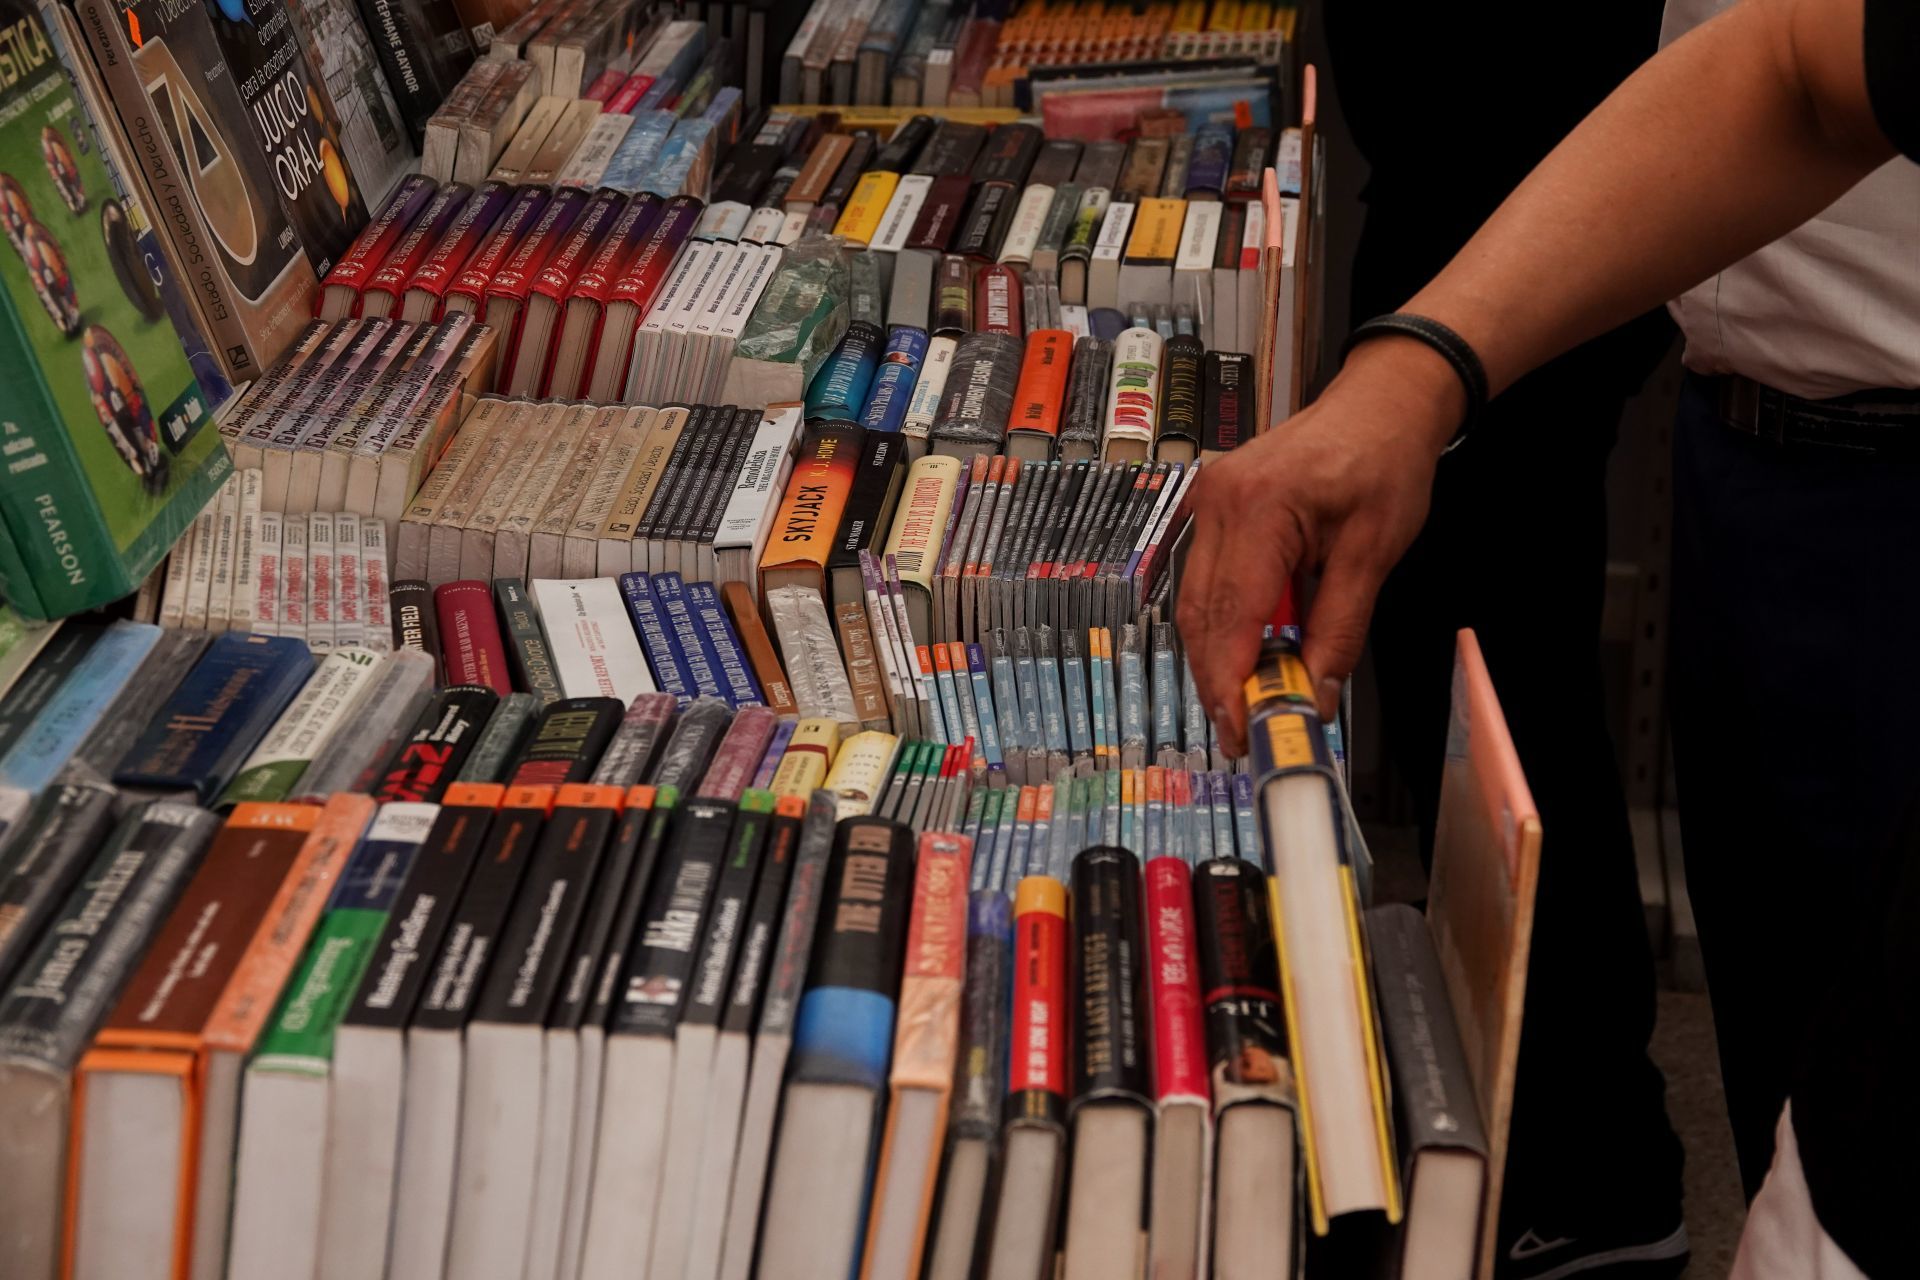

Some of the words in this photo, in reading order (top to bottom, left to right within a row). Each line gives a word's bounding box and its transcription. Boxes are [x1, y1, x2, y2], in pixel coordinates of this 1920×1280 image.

[87, 6, 119, 67] Pereznieto
[374, 0, 402, 48] TEPHANE
[394, 49, 420, 94] RAYNOR
[0, 14, 53, 95] STICA
[240, 76, 259, 107] para
[253, 70, 308, 153] JUICIO
[135, 116, 169, 181] Derecho
[276, 127, 326, 201] ORAL
[165, 194, 204, 265] Sociedad
[201, 266, 228, 322] Estado,
[971, 359, 993, 386] LEASING
[1169, 355, 1197, 403] PICTURE
[872, 383, 895, 407] PILLARS
[961, 384, 985, 419] EQUIPMENT
[231, 408, 256, 429] Derecho
[262, 409, 286, 430] Derecho
[867, 401, 884, 420] SEVEN
[286, 414, 311, 436] Derecho
[318, 417, 342, 439] Derecho
[348, 416, 371, 439] Derecho
[375, 418, 399, 443] Derecho
[406, 418, 428, 440] Derecho
[1216, 424, 1238, 450] AFTER
[619, 495, 641, 515] Estado,
[630, 470, 651, 495] Sociedad
[642, 444, 663, 466] Derecho
[738, 450, 768, 491] Remodelista
[783, 485, 828, 542] SKYJACK
[816, 437, 839, 459] HOWE
[911, 477, 944, 511] DEMOCRACY
[34, 494, 86, 586] PEARSON
[848, 520, 865, 537] MAKER
[902, 519, 932, 541] PEOPLE
[844, 536, 859, 551] STAR
[899, 538, 927, 550] THE
[896, 550, 925, 573] MOUNK
[401, 605, 420, 632] FIELD
[523, 639, 551, 669] Divorce
[590, 654, 610, 677] REPORT
[14, 924, 92, 1004] James
[56, 851, 146, 937] Burnham
